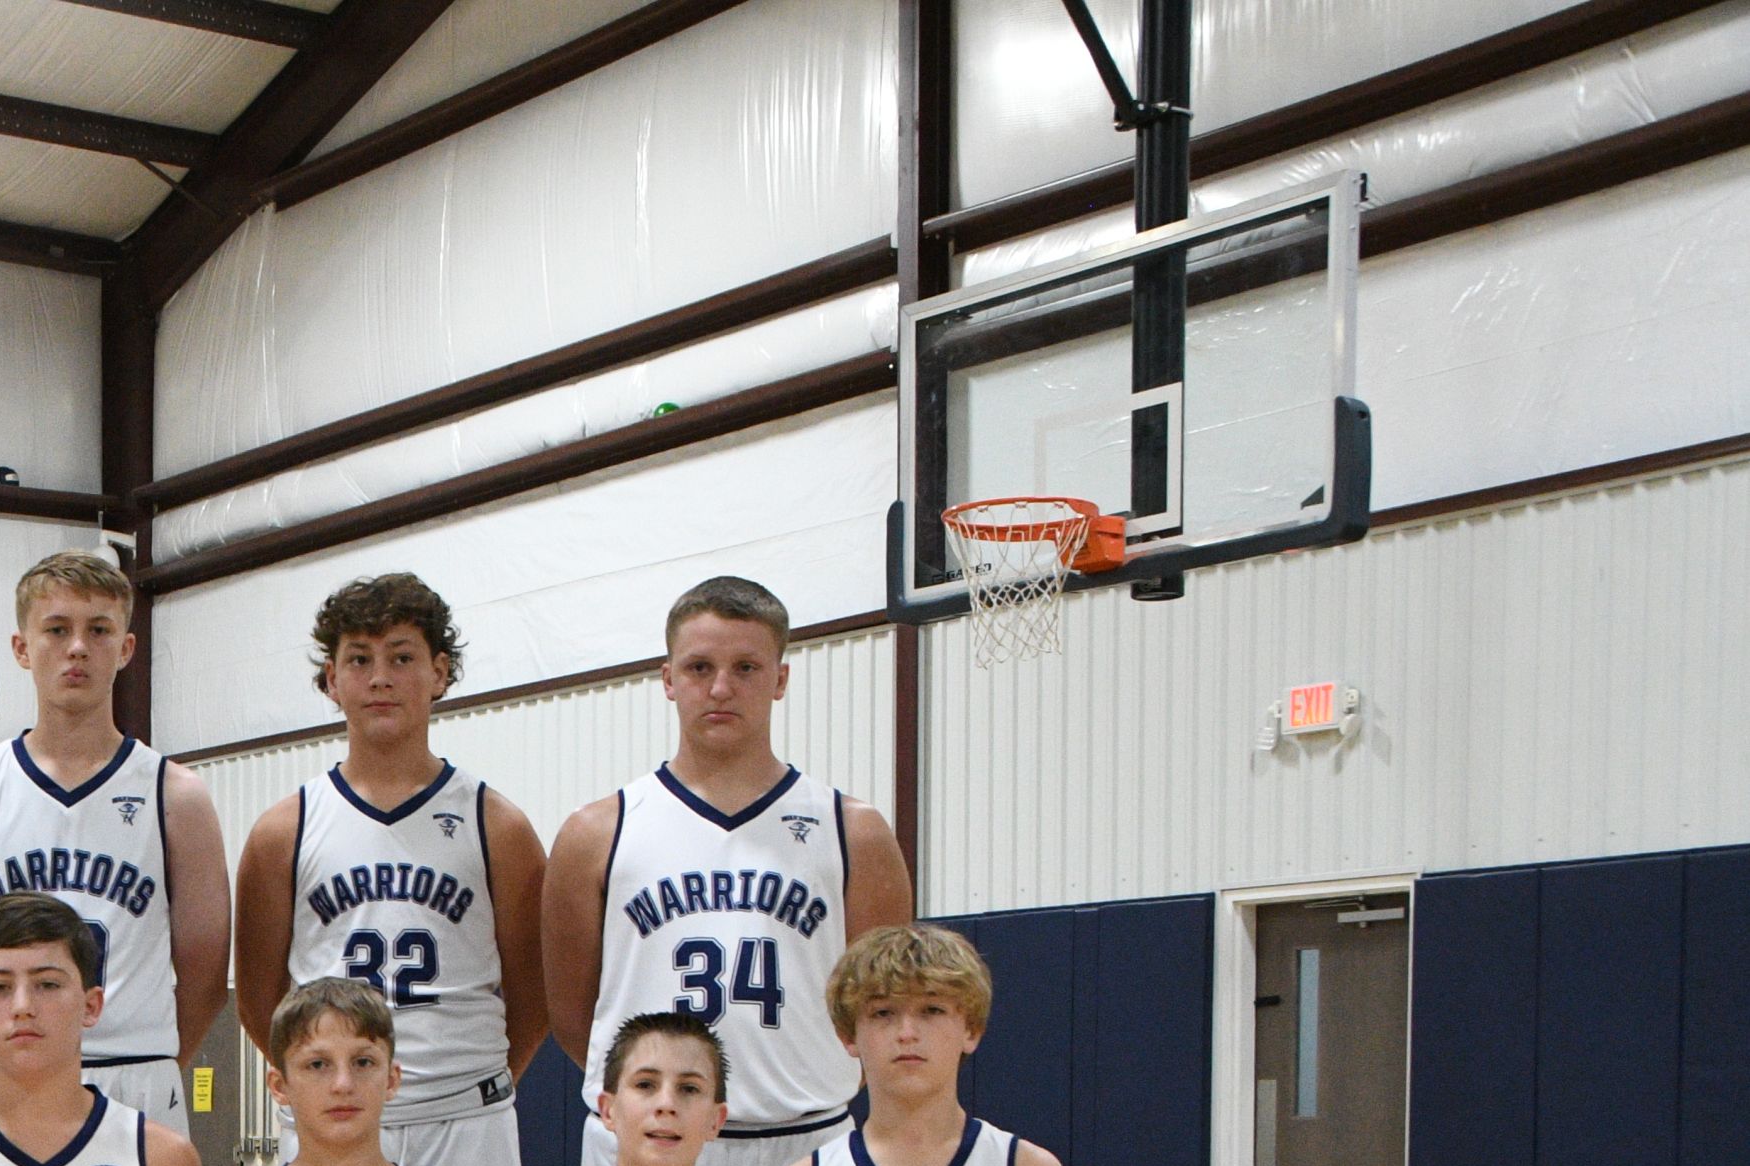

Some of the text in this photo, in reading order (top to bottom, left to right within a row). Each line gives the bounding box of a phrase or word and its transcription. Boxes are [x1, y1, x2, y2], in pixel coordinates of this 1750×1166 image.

[1290, 682, 1334, 727] EXIT
[308, 863, 475, 926] WARRIORS
[623, 869, 827, 939] WARRIORS
[342, 928, 440, 1010] 32
[672, 937, 784, 1029] 34
